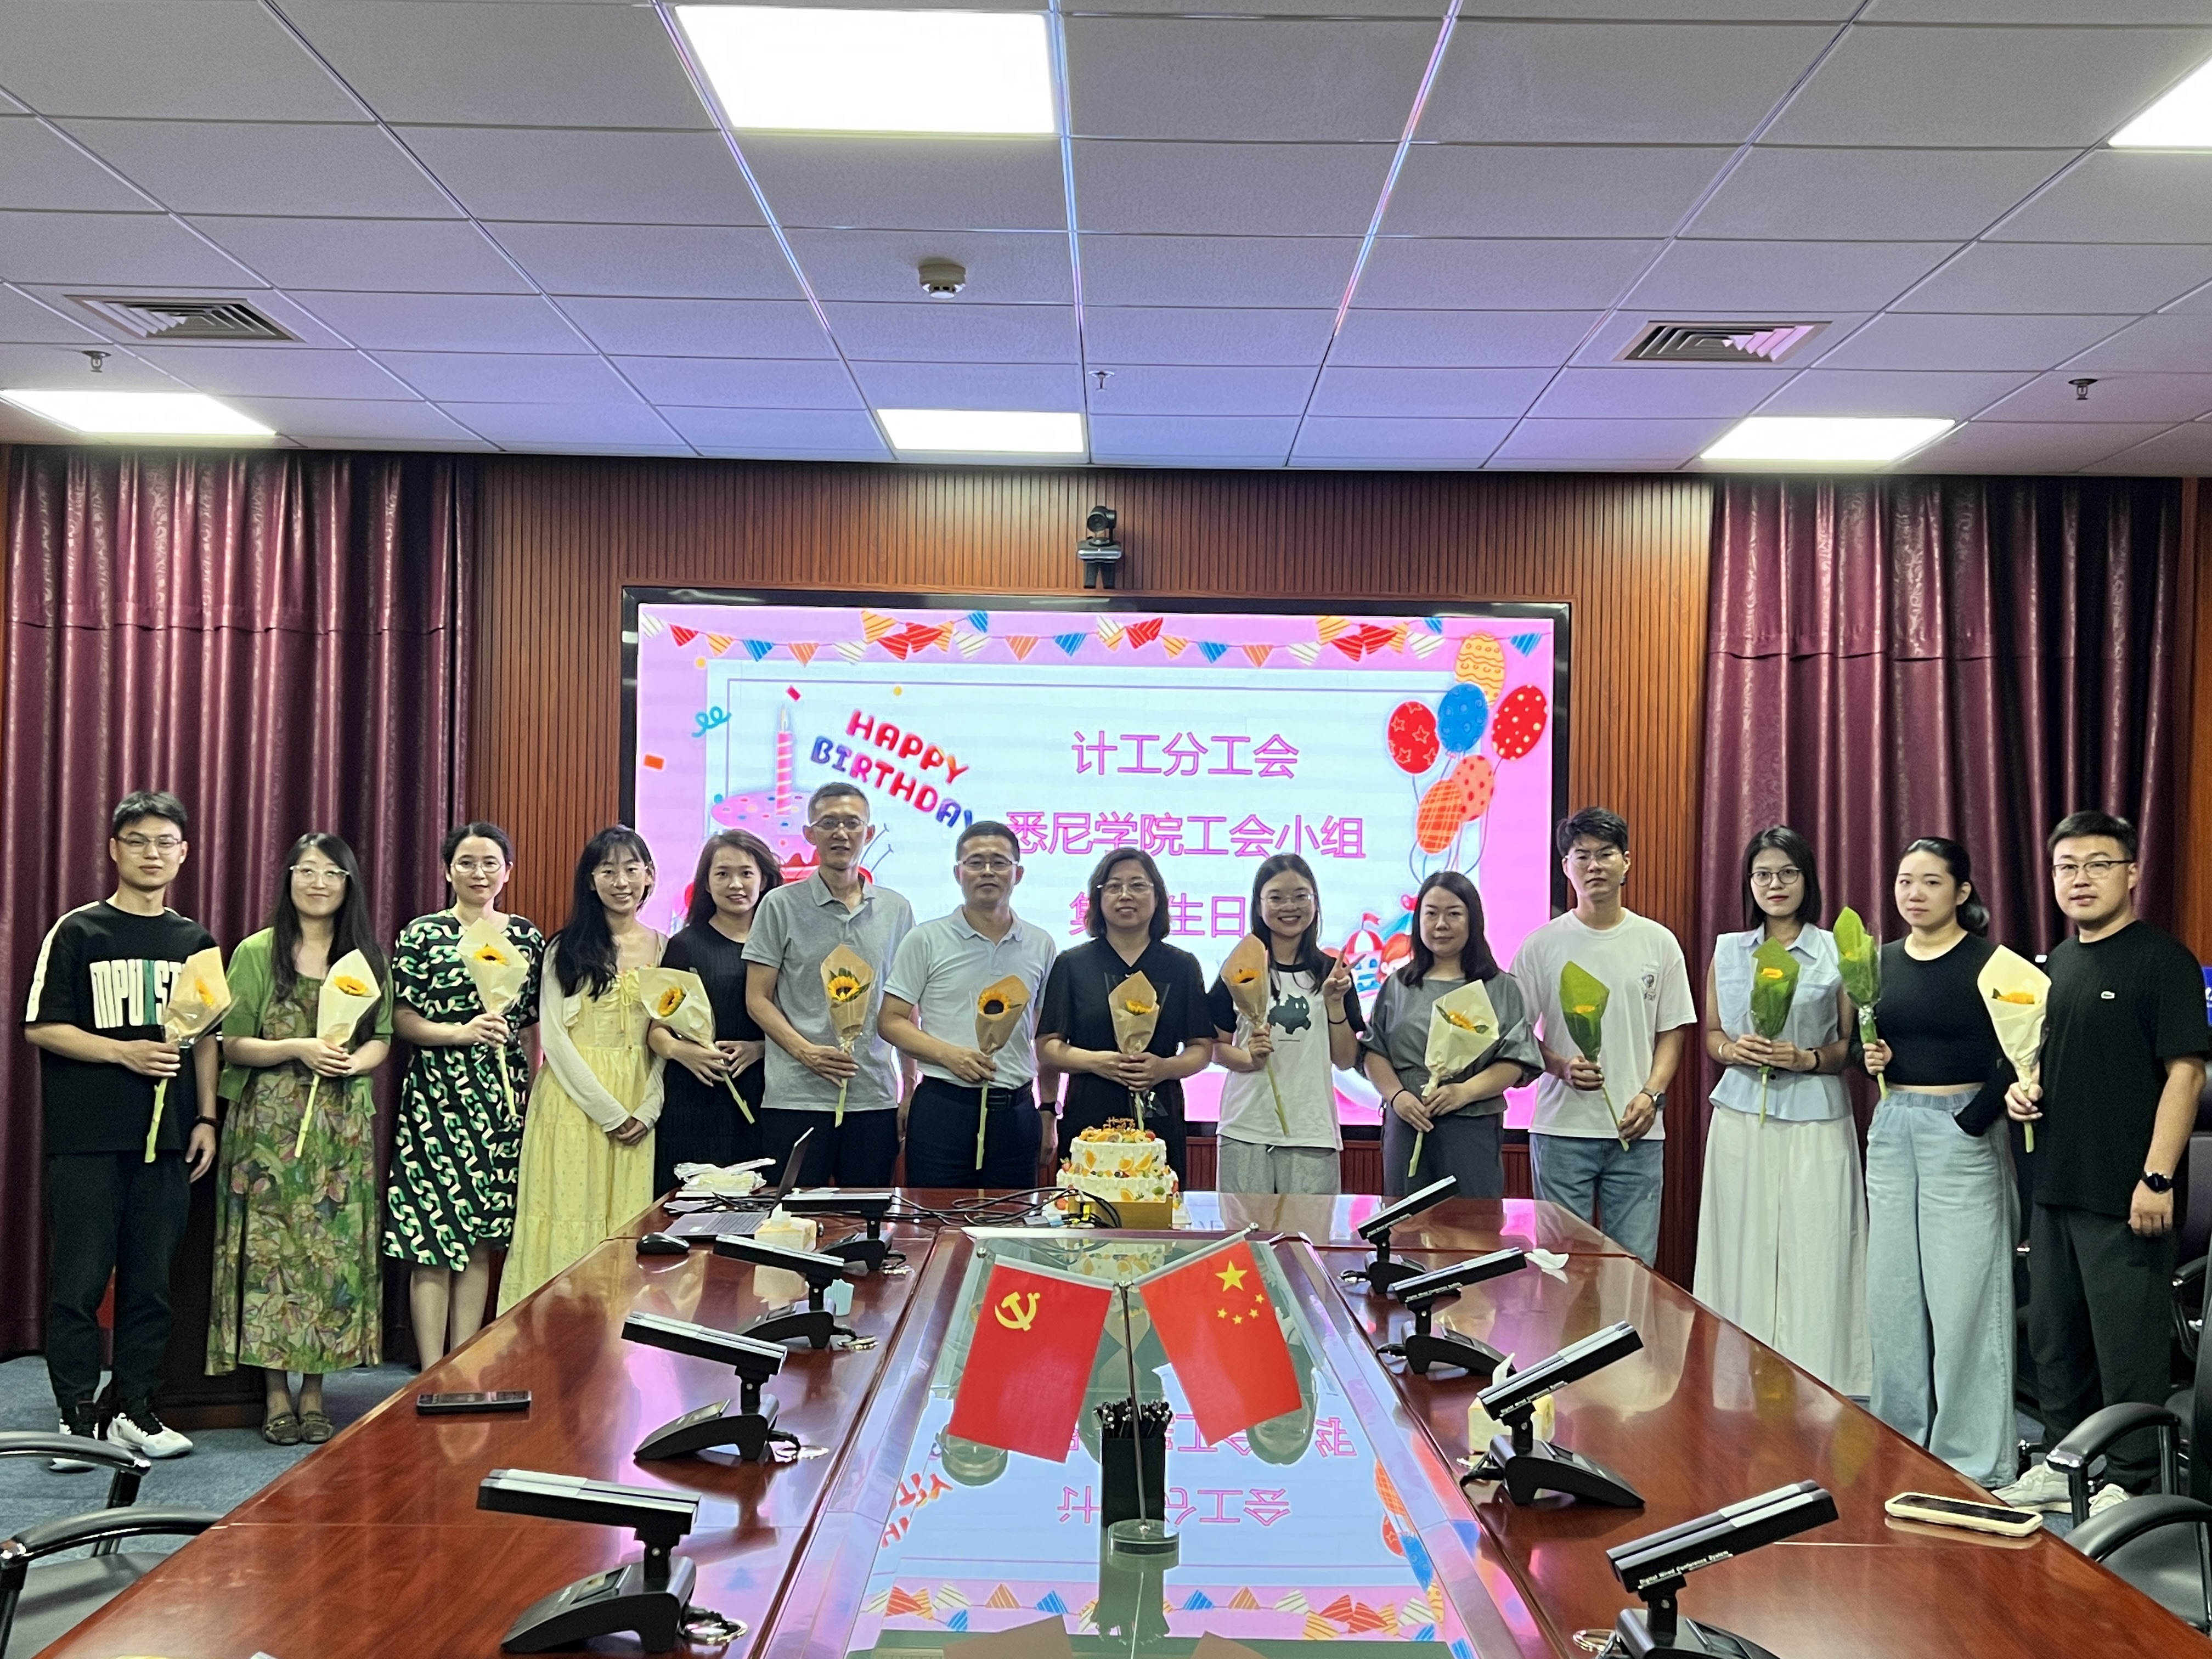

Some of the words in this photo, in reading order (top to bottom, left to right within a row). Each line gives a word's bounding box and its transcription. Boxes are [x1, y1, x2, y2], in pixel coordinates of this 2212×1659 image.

[845, 709, 969, 785] HAPPY
[1071, 730, 1300, 778] 计工分工会
[1006, 811, 1367, 859] 悉尼学院工会小组
